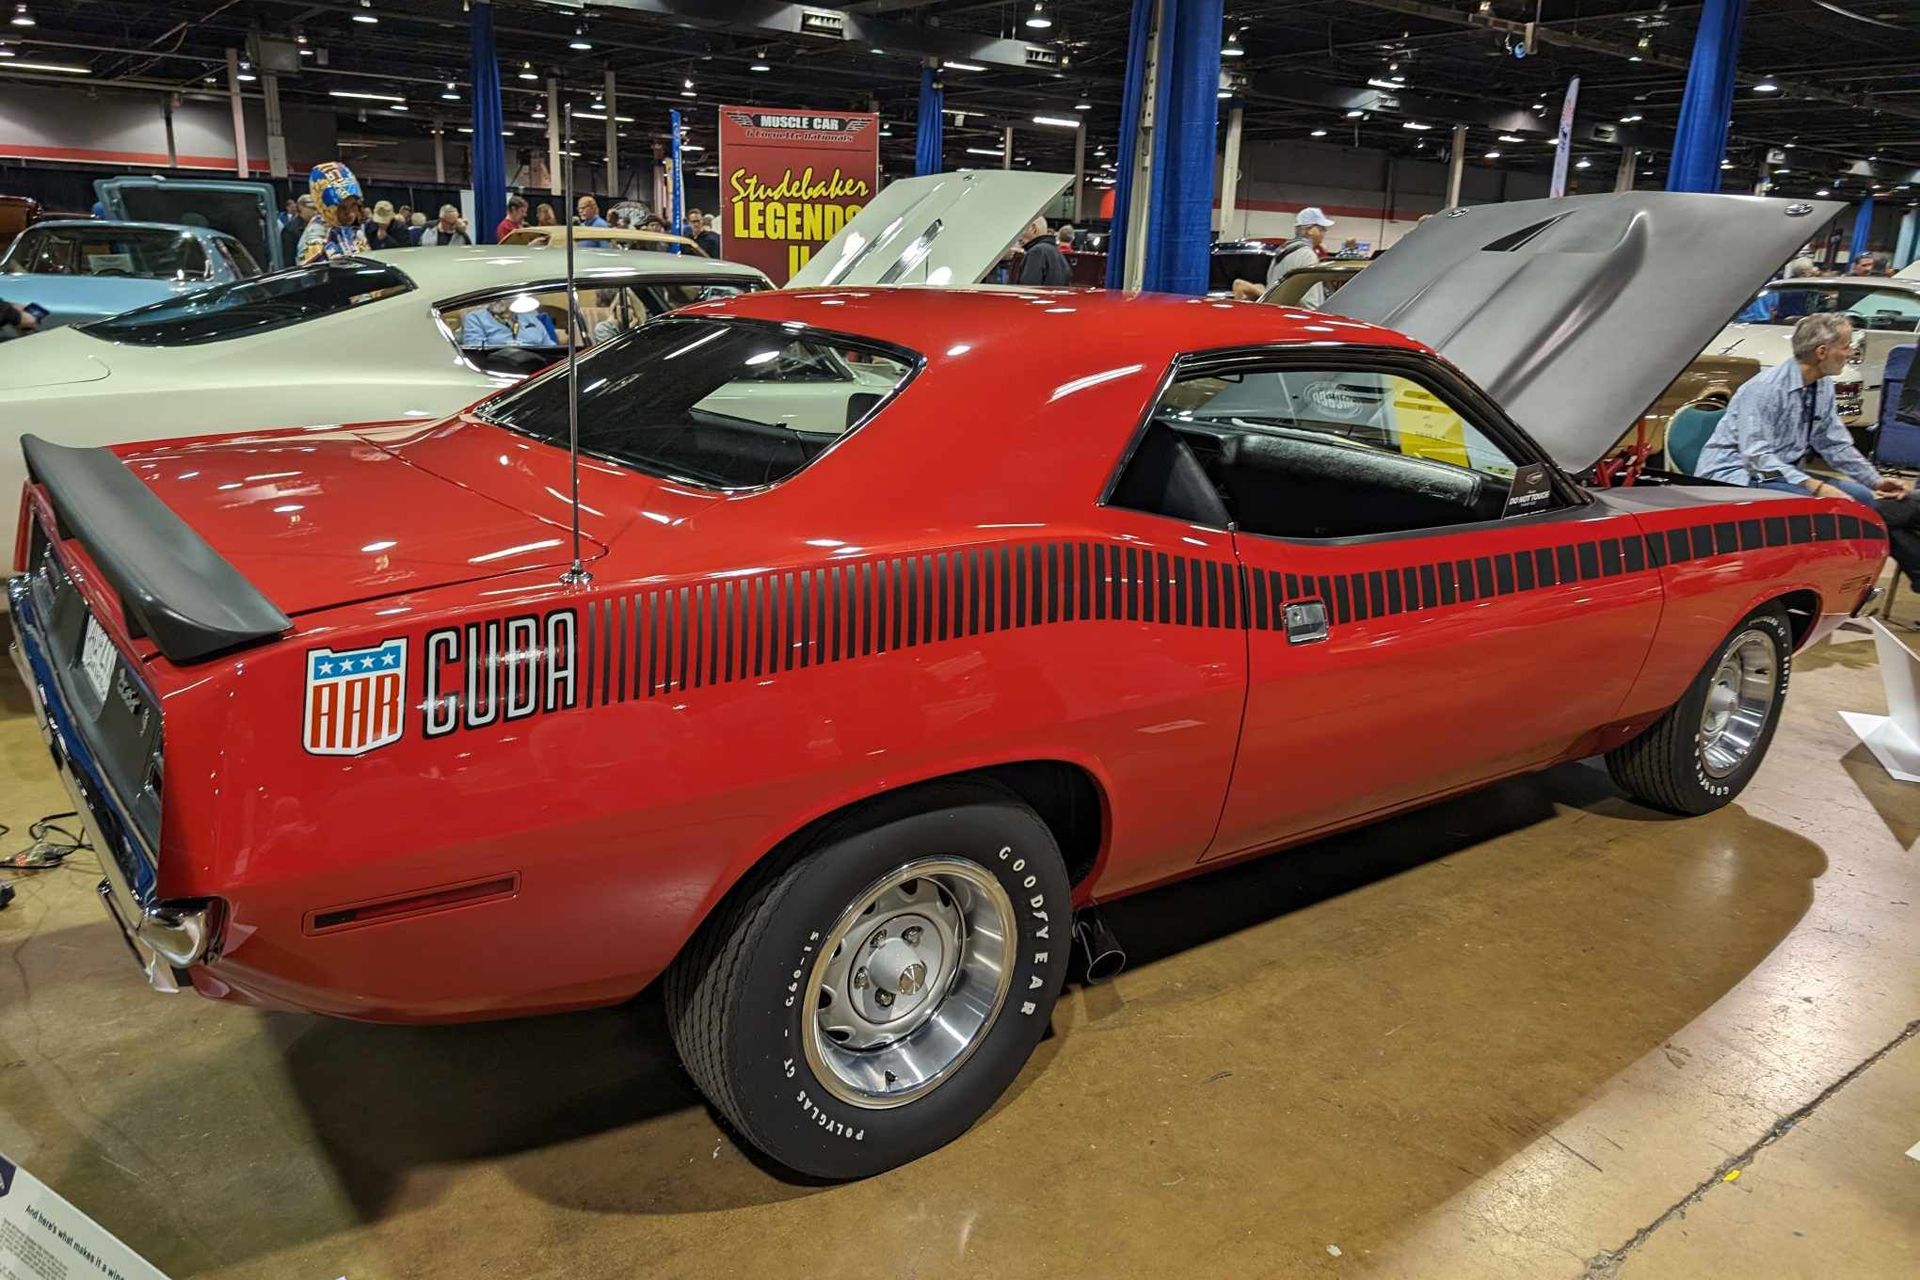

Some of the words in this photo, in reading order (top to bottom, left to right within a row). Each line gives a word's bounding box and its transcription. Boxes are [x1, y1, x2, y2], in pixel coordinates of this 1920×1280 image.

[760, 115, 810, 129] MUSCLE
[812, 117, 839, 131] CAR
[730, 167, 870, 202] Studebaker
[422, 607, 577, 739] CUDA
[310, 673, 400, 749] AAR
[998, 846, 1050, 1017] GOODYEAR
[796, 1090, 865, 1141] POLYGLAS
[25, 1204, 39, 1220] And
[58, 1230, 73, 1247] what
[73, 1242, 94, 1263] makes
